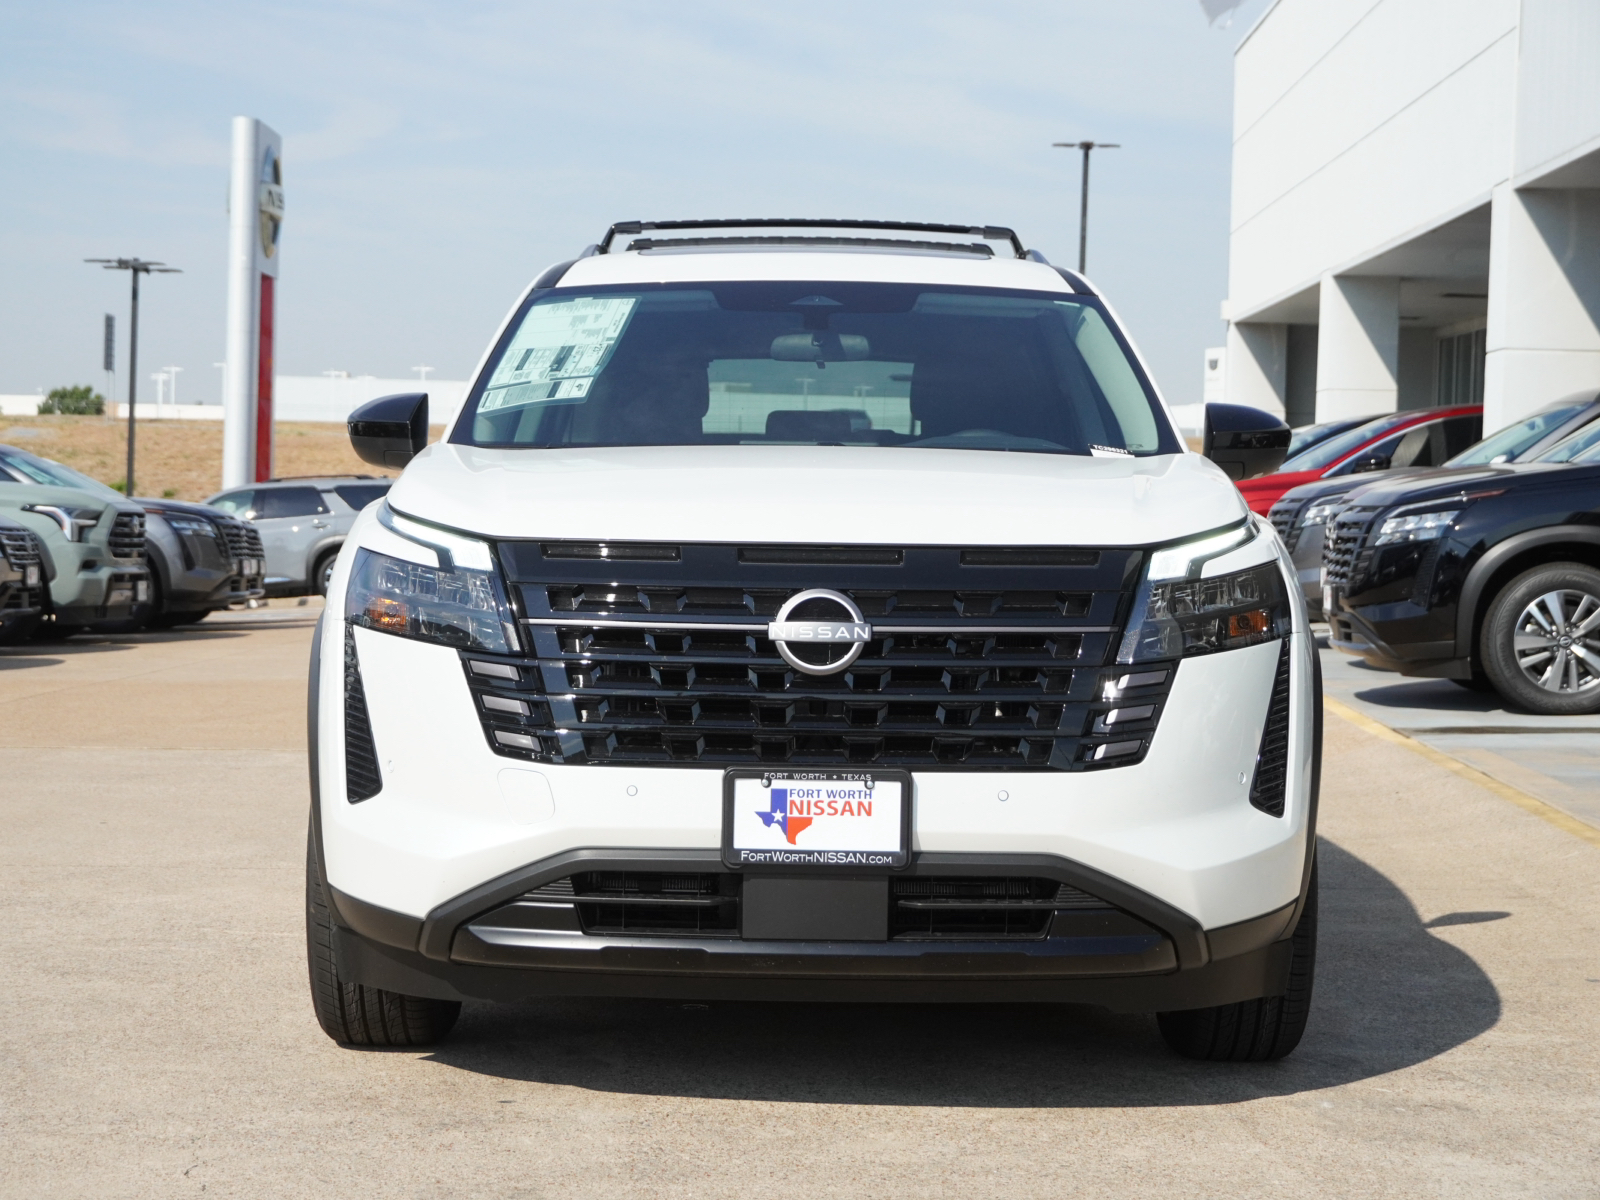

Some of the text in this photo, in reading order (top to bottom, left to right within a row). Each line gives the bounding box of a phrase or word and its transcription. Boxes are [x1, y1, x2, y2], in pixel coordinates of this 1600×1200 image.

[771, 626, 869, 639] NISSAN
[764, 772, 872, 781] FORT WORTH TEXAS
[789, 788, 872, 800] FORT WORTH
[789, 799, 872, 817] NISSAN
